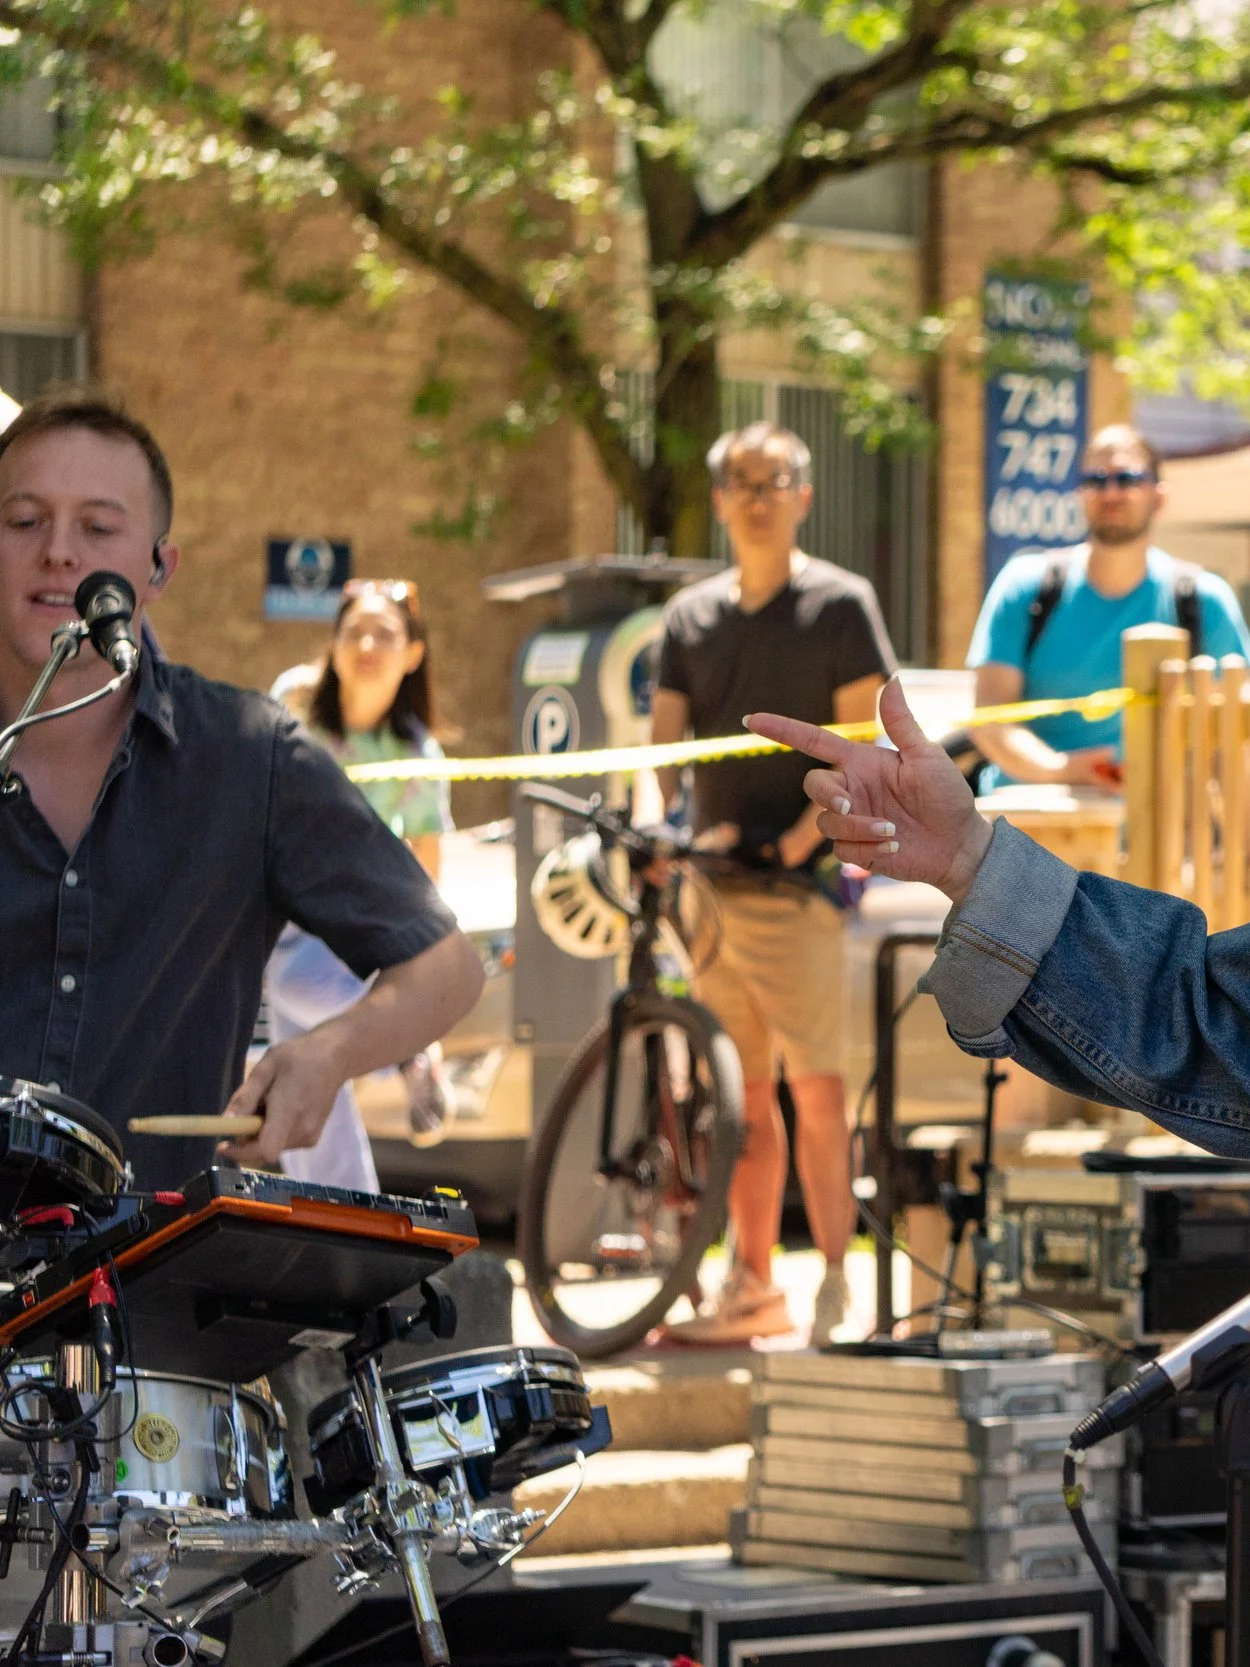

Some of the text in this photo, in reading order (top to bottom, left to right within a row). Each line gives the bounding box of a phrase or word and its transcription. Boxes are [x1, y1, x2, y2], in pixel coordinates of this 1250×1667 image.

[998, 373, 1078, 429] 734
[997, 430, 1078, 485] 747
[989, 486, 1089, 541] 6000
[537, 699, 567, 756] P
